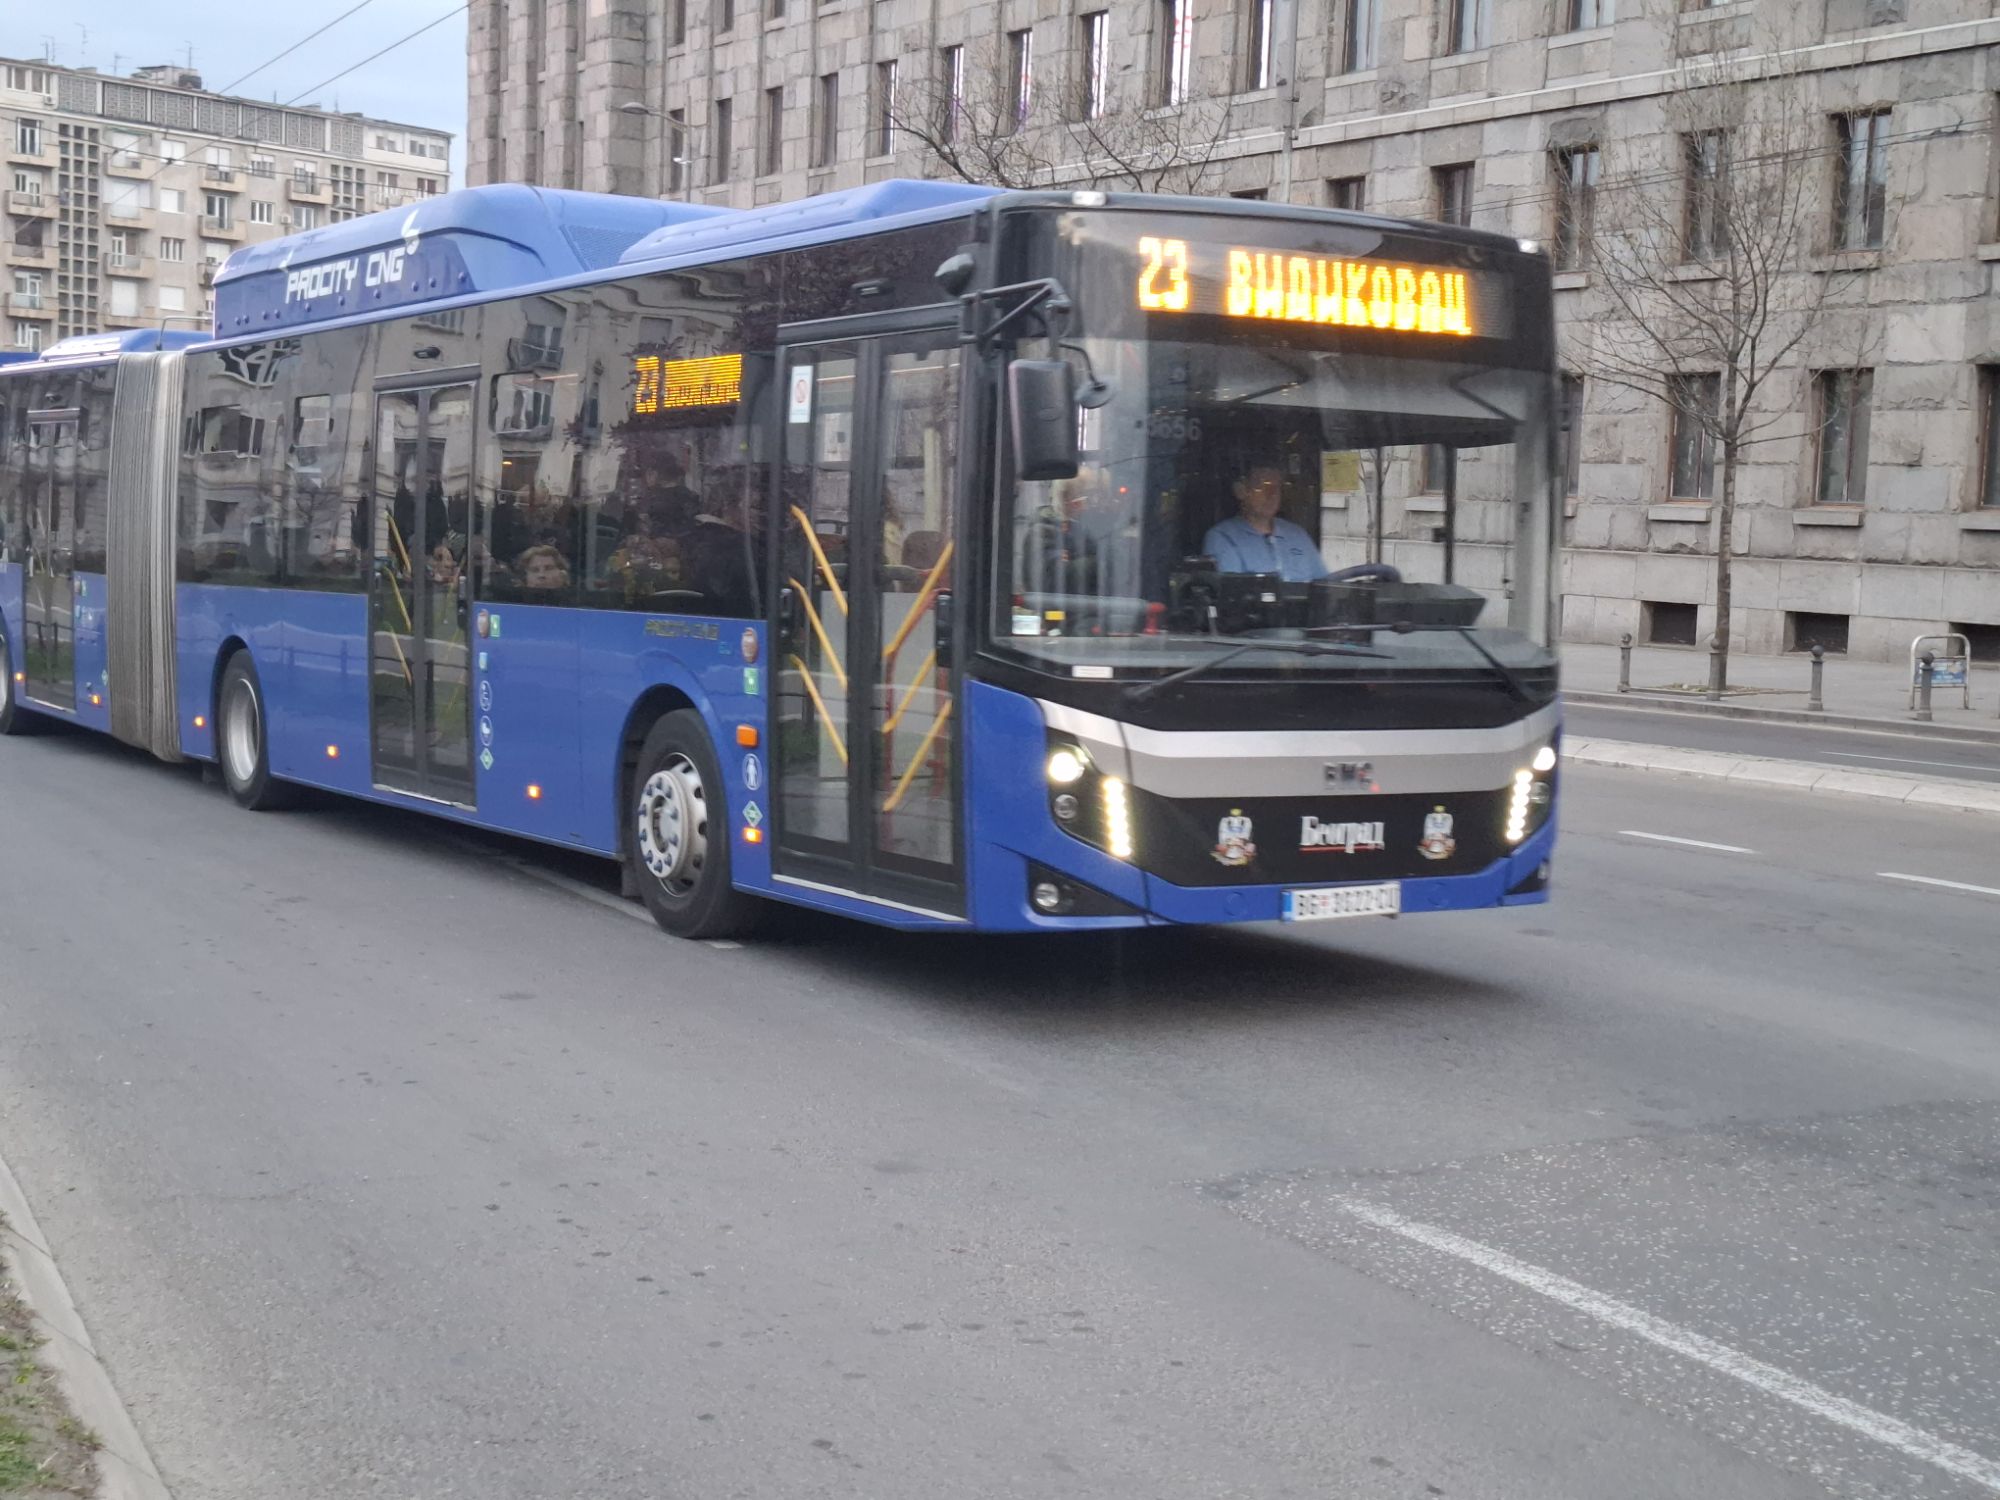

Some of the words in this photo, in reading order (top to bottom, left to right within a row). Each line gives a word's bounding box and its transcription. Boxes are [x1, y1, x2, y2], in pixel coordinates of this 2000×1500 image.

[285, 258, 359, 304] PROCITY
[365, 247, 406, 288] CNG
[1138, 236, 1188, 311] 23
[1229, 251, 1471, 335] ВИДИКОВАЦ
